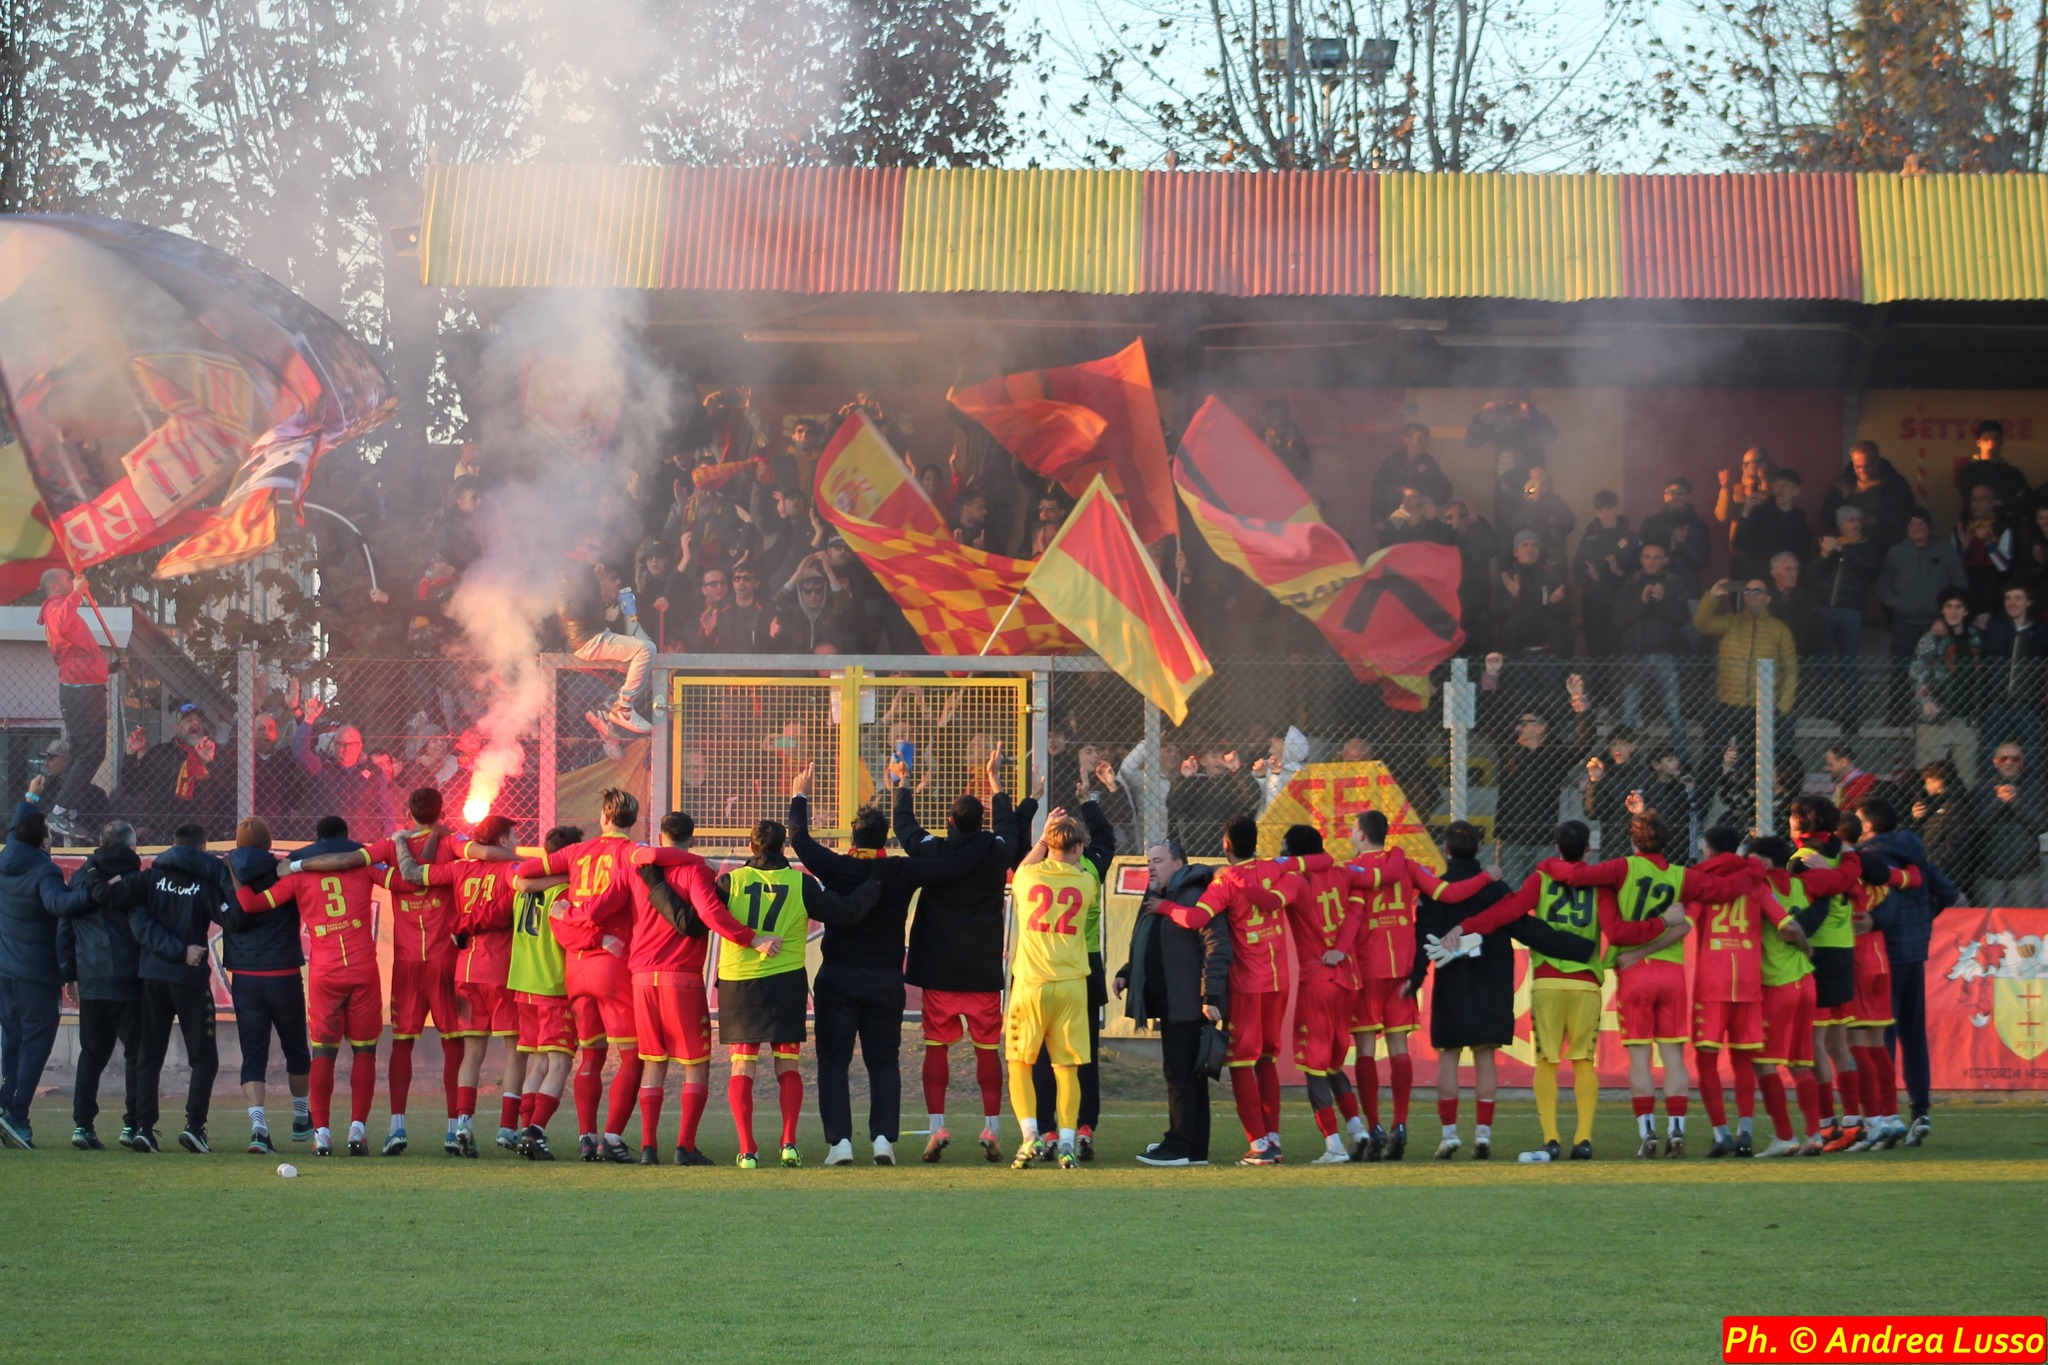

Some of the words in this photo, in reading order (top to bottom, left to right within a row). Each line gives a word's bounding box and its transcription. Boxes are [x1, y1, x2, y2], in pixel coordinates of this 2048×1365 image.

[320, 876, 347, 917] 3
[576, 854, 613, 897] 16
[744, 882, 789, 932] 17
[1027, 885, 1083, 936] 22
[1547, 881, 1594, 927] 29
[1630, 876, 1676, 922] 12
[1961, 1067, 2022, 1080] VICTORIA
